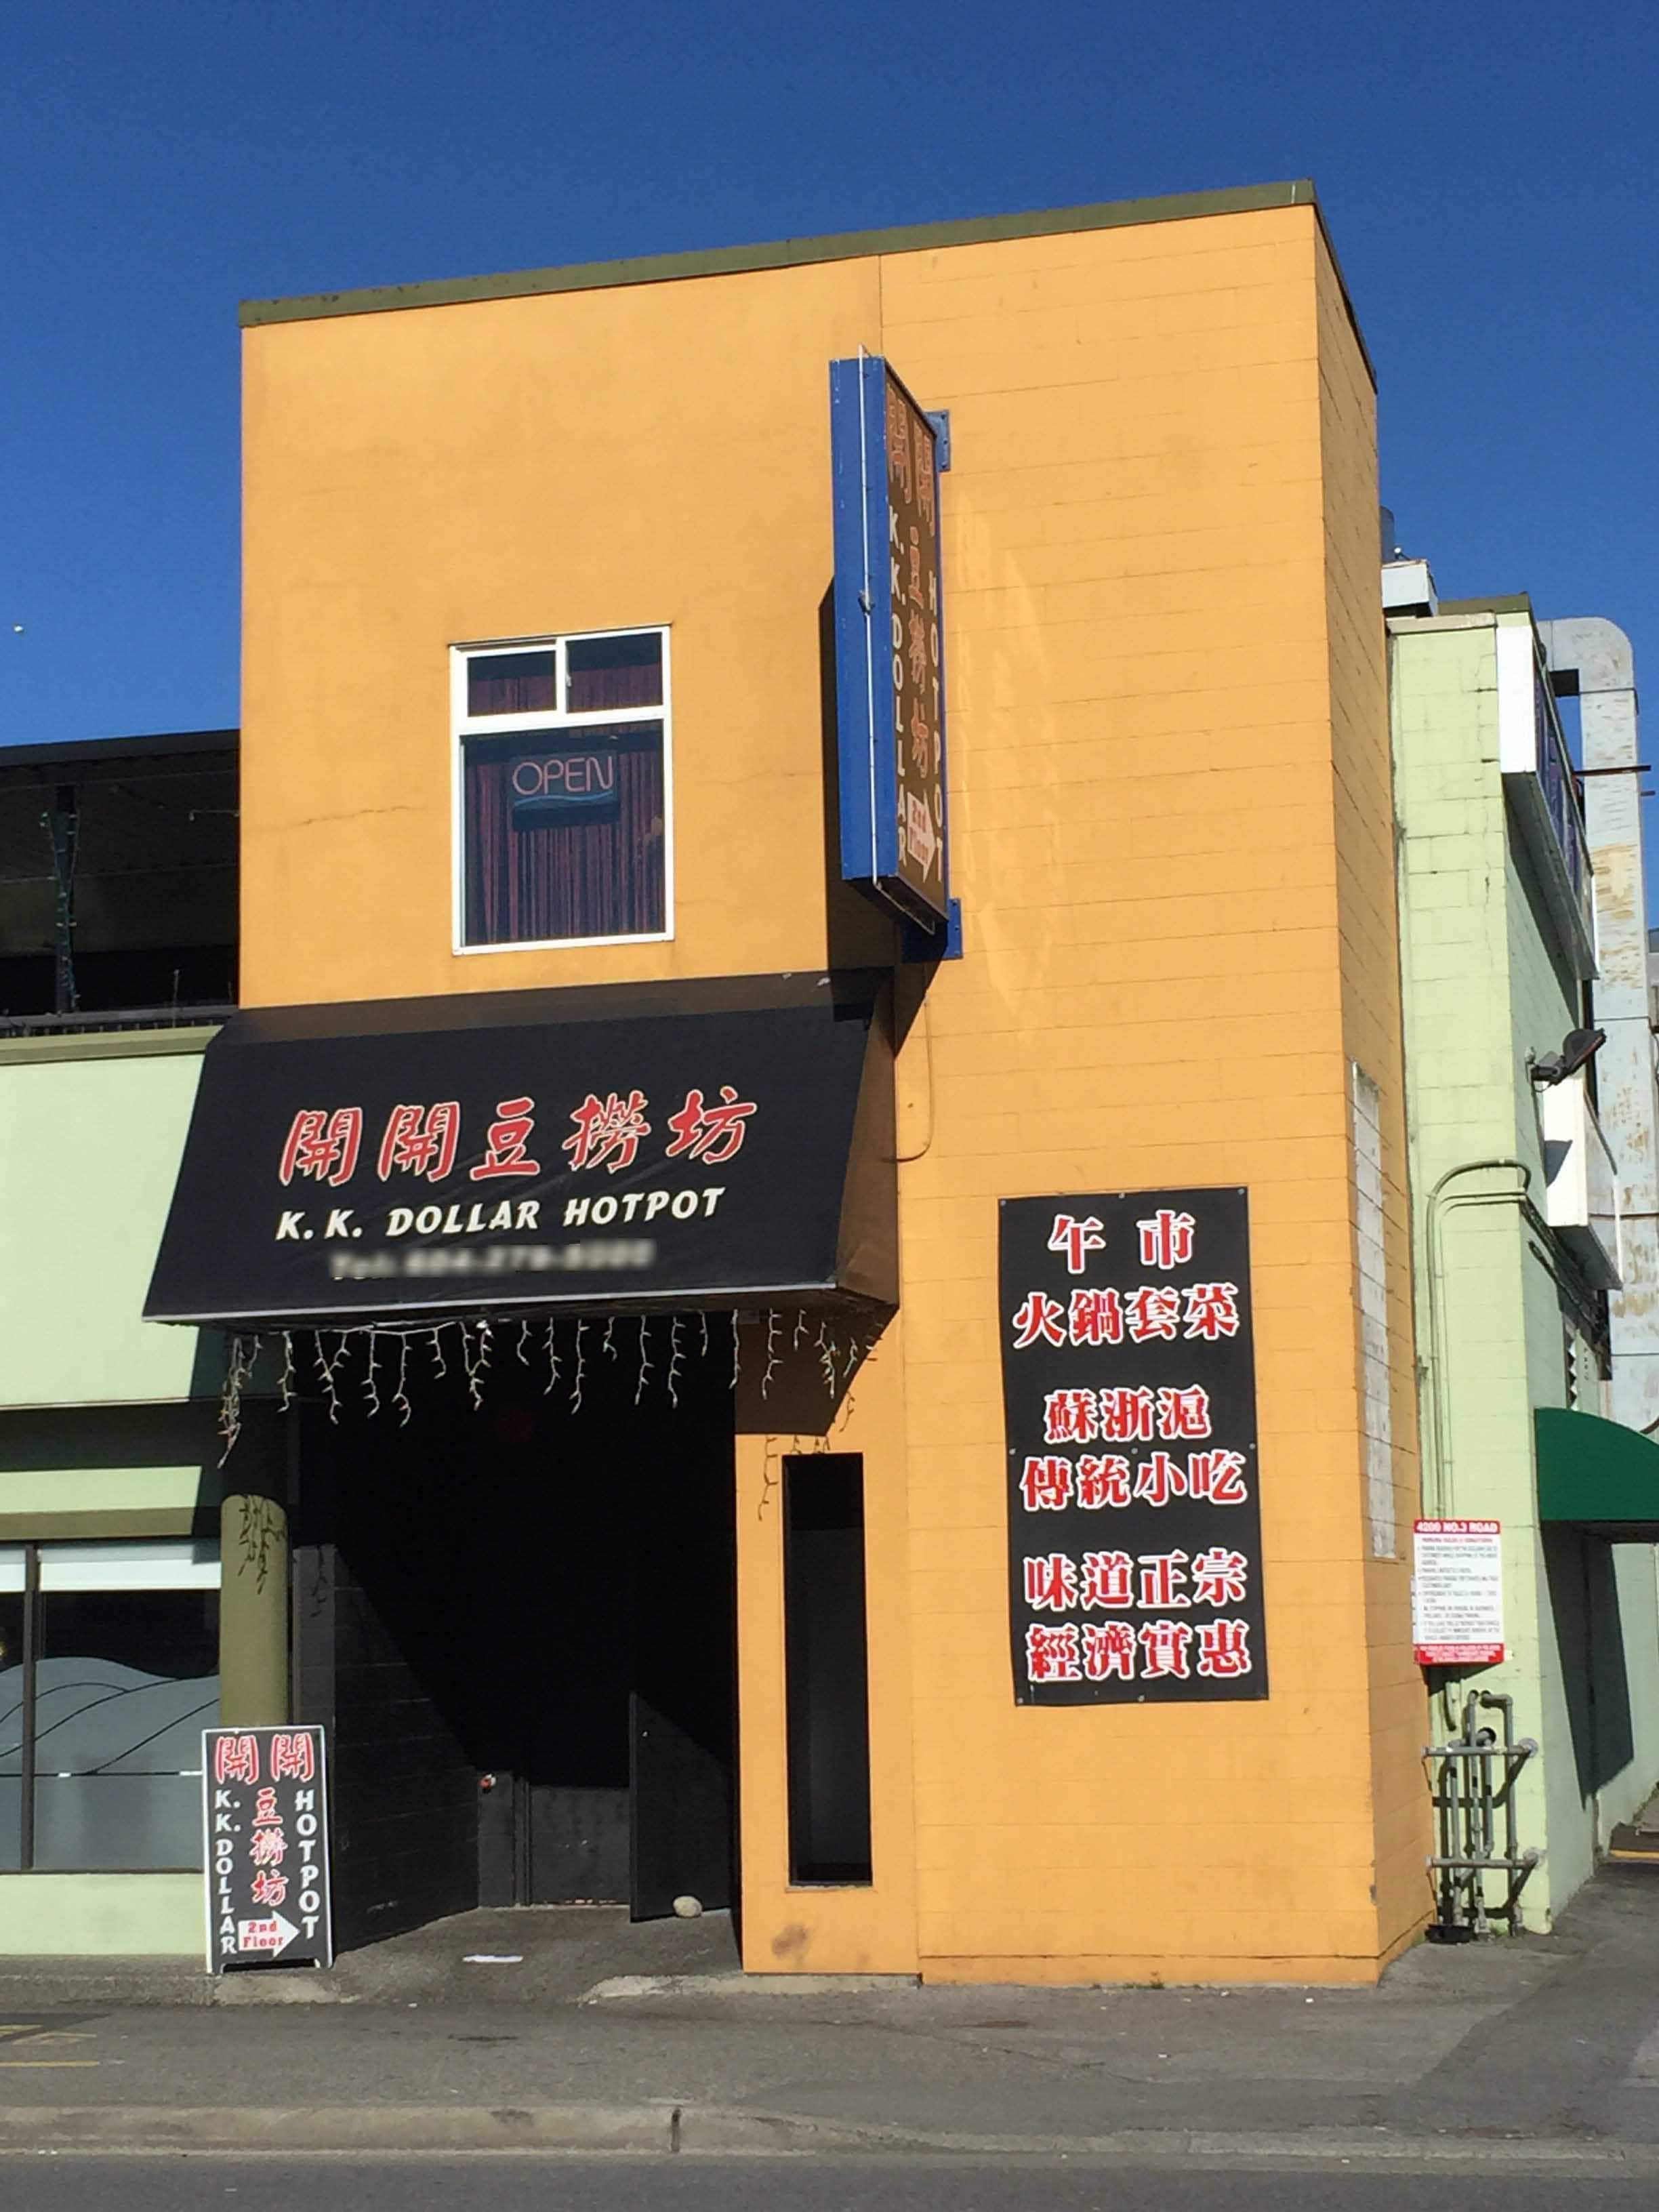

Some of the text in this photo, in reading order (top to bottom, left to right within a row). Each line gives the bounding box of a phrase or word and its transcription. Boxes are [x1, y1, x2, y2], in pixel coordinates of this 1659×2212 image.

[891, 613, 907, 867] DOLLAR
[928, 570, 943, 882] HOTPOT
[512, 755, 614, 796] OPEN
[278, 1085, 758, 1187] 開開豆撈坊
[386, 1200, 540, 1236] DOLLAR
[562, 1187, 726, 1227] HOTPOT
[1048, 1210, 1195, 1274] 午市
[1012, 1282, 1240, 1349] 火鍋套菜
[1019, 1449, 1248, 1511] 傳統小吃
[1023, 1547, 1248, 1612] 味道正宗
[1025, 1618, 1252, 1683] 經濟實惠
[214, 1732, 315, 1785] 開開
[249, 1786, 289, 1907] 豆撈坊
[294, 1789, 321, 1940] HOTPOT
[215, 1839, 237, 1954] DOLLAR
[248, 1921, 277, 1933] 2nd
[243, 1936, 283, 1948] Floor
